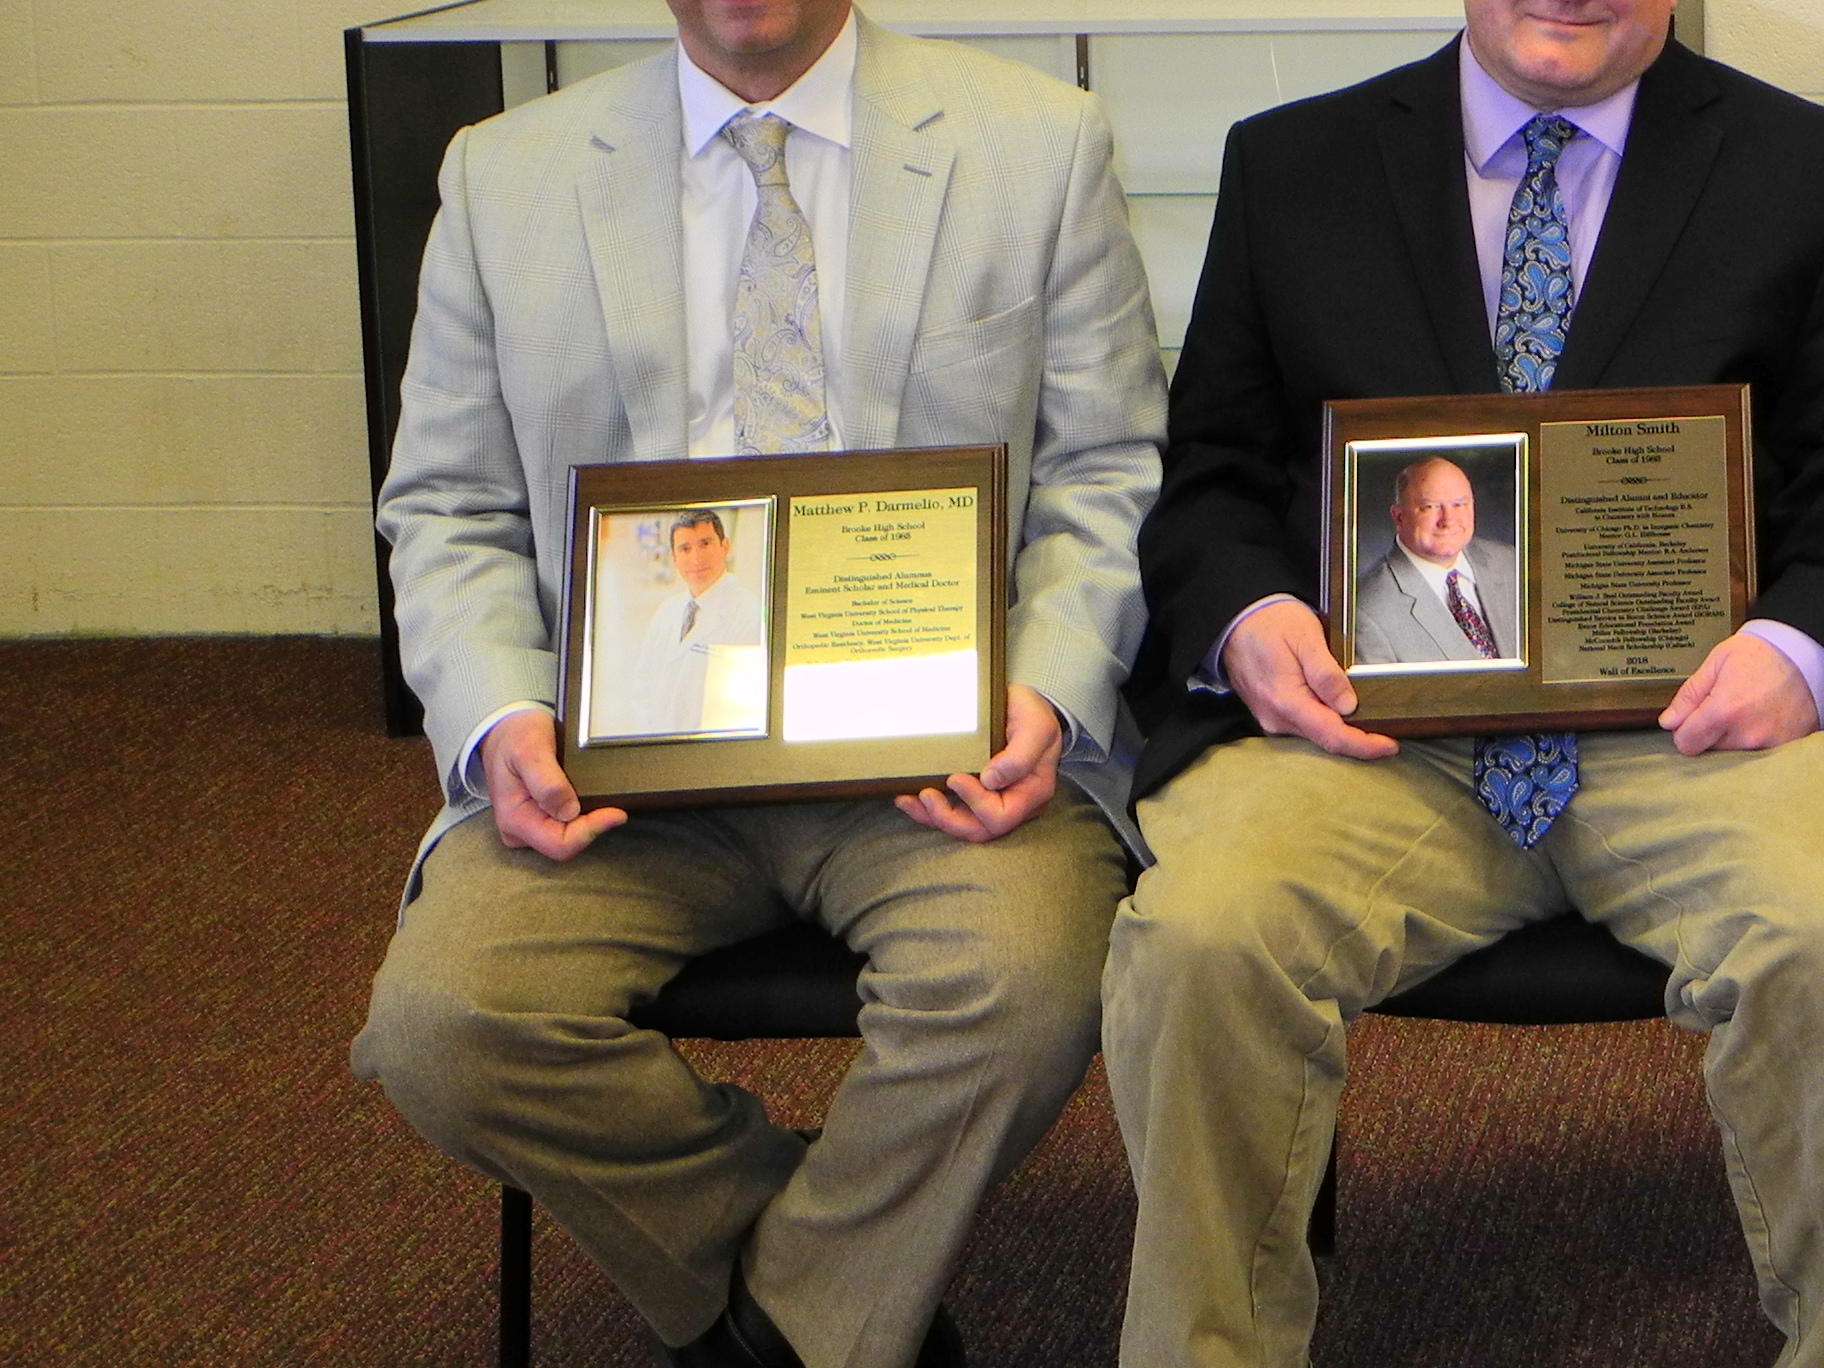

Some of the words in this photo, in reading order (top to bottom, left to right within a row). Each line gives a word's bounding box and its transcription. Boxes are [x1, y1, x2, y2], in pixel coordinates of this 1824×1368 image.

[1586, 424, 1632, 437] Milton
[1637, 422, 1680, 435] Smith
[1624, 446, 1644, 455] High
[1647, 445, 1674, 453] School
[1631, 455, 1639, 463] of
[794, 504, 854, 517] Matthew
[858, 501, 871, 513] P.
[876, 498, 944, 512] Darmelio,
[949, 496, 974, 507] MD
[874, 524, 894, 532] High
[897, 522, 925, 530] School
[834, 573, 892, 582] Distinguished
[895, 571, 932, 579] Alumnus
[805, 585, 841, 594] Eminent
[843, 584, 875, 592] Scholar
[878, 582, 893, 590] and
[896, 581, 928, 589] Medical
[931, 579, 960, 587] Doctor
[1600, 667, 1619, 676] Wall
[1621, 667, 1630, 675] of
[1632, 667, 1675, 675] Excellence
